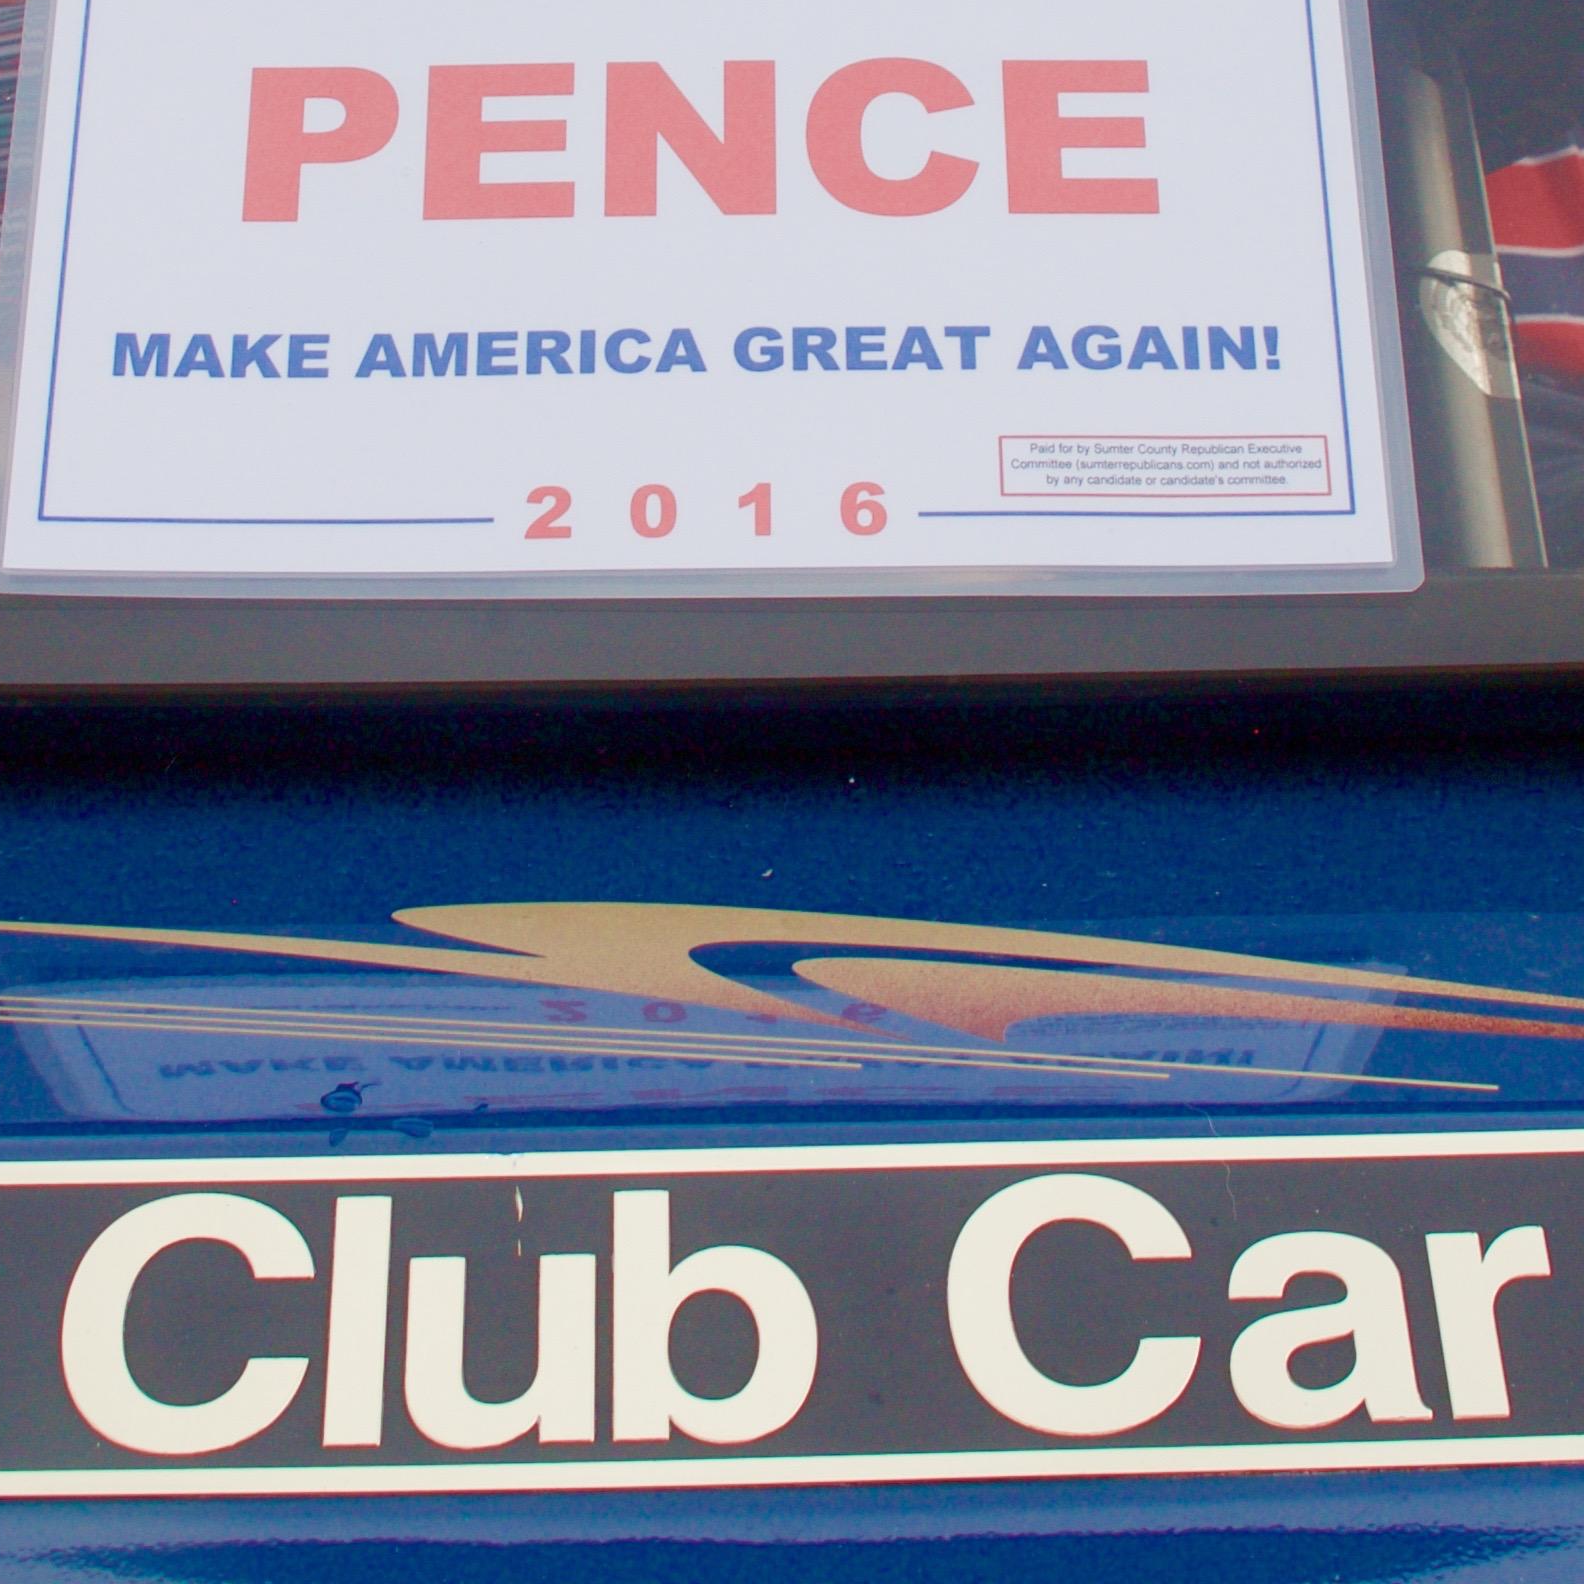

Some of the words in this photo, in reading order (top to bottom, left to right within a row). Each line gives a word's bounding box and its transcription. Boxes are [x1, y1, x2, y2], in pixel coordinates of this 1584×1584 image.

[242, 57, 1160, 222] PENCE
[112, 332, 329, 379] MAKE
[355, 329, 706, 378] AMERICA
[733, 326, 992, 373] GREAT
[1018, 326, 1282, 371] AGAIN!
[1011, 458, 1073, 469] Committee
[1076, 458, 1214, 471] (sumterrepublicans.com)
[1218, 458, 1239, 469] and
[1243, 458, 1260, 469] not
[1264, 458, 1322, 469] authorized
[1030, 443, 1055, 454] Paid
[1059, 443, 1073, 454] for
[1077, 443, 1090, 456] by
[1094, 443, 1134, 454] Sumter
[1137, 443, 1177, 456] County
[1181, 443, 1245, 456] Republican
[1248, 443, 1303, 454] Executive
[1046, 475, 1059, 487] by
[1064, 476, 1083, 487] any
[1087, 475, 1142, 485] candidate
[1145, 476, 1157, 485] or
[1160, 475, 1225, 485] candidate's
[525, 482, 889, 540] 2016
[60, 1188, 820, 1455] Club
[946, 1172, 1552, 1437] Car
